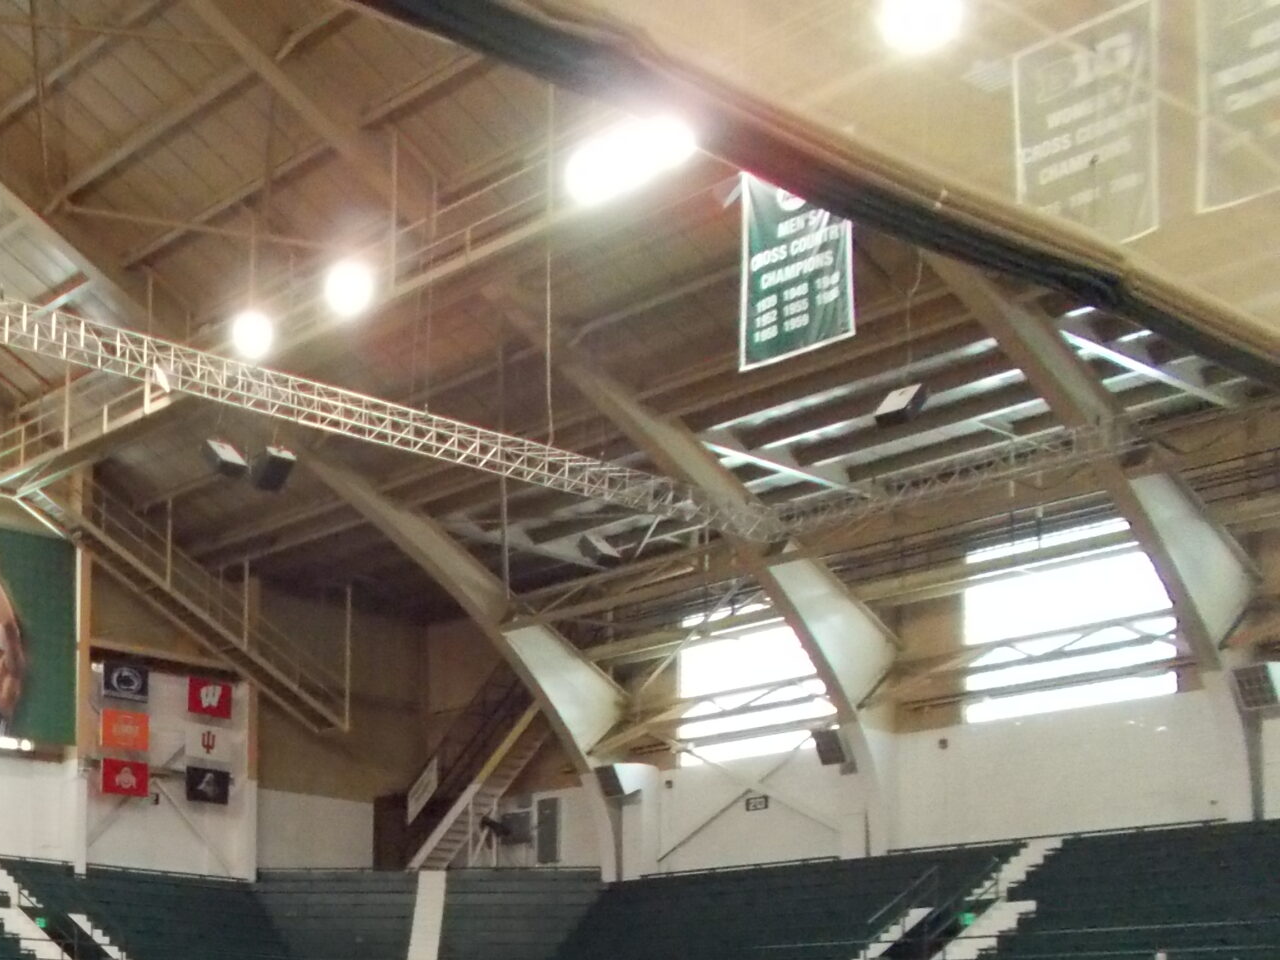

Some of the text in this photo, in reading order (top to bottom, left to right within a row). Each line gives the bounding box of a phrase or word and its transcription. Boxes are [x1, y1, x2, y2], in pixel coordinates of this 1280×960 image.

[1020, 133, 1072, 165] CROSS
[750, 244, 788, 271] CROSS
[760, 250, 834, 290] CHAMPIONS
